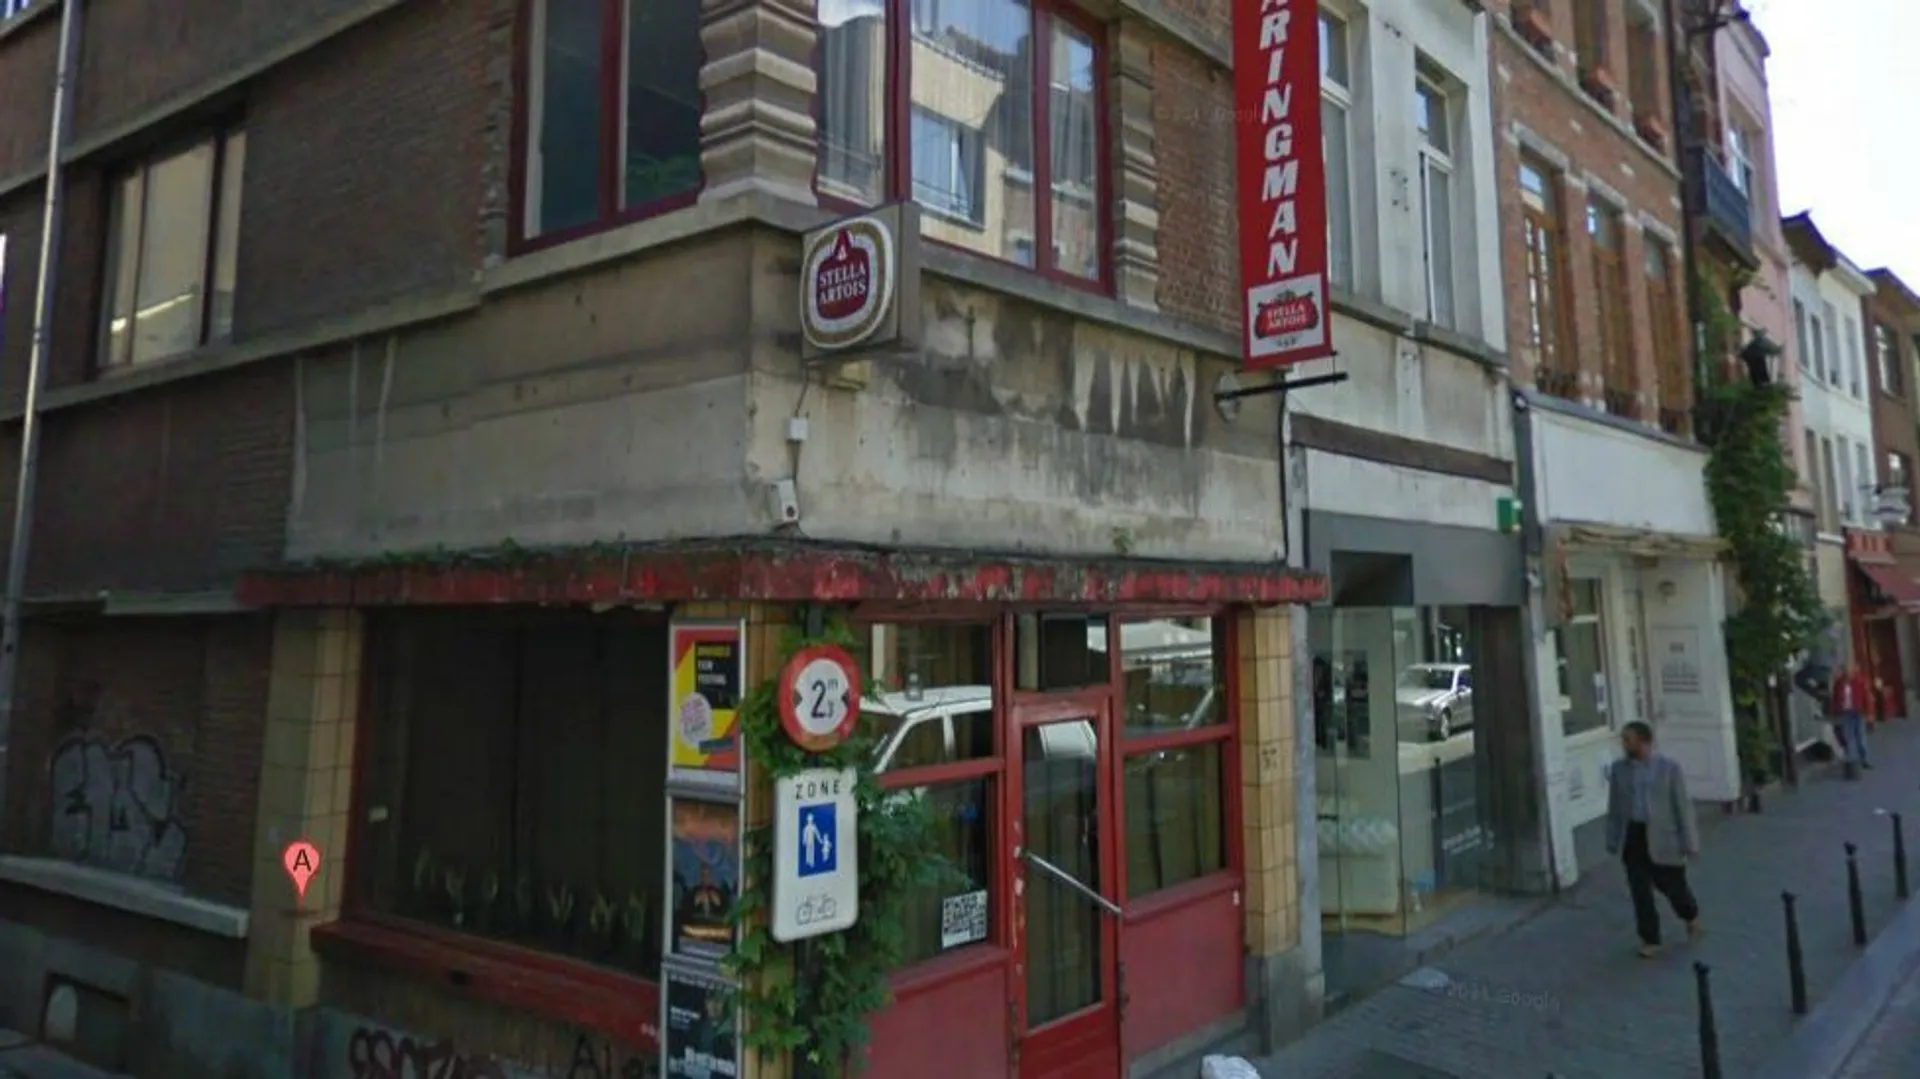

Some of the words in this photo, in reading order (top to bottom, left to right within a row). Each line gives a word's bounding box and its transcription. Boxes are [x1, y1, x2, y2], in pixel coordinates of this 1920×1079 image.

[819, 261, 867, 287] STELLA
[819, 280, 868, 305] ARTOIS
[1267, 303, 1306, 320] STELLA
[1267, 312, 1308, 330] ARTOIS
[795, 779, 841, 800] ZONE
